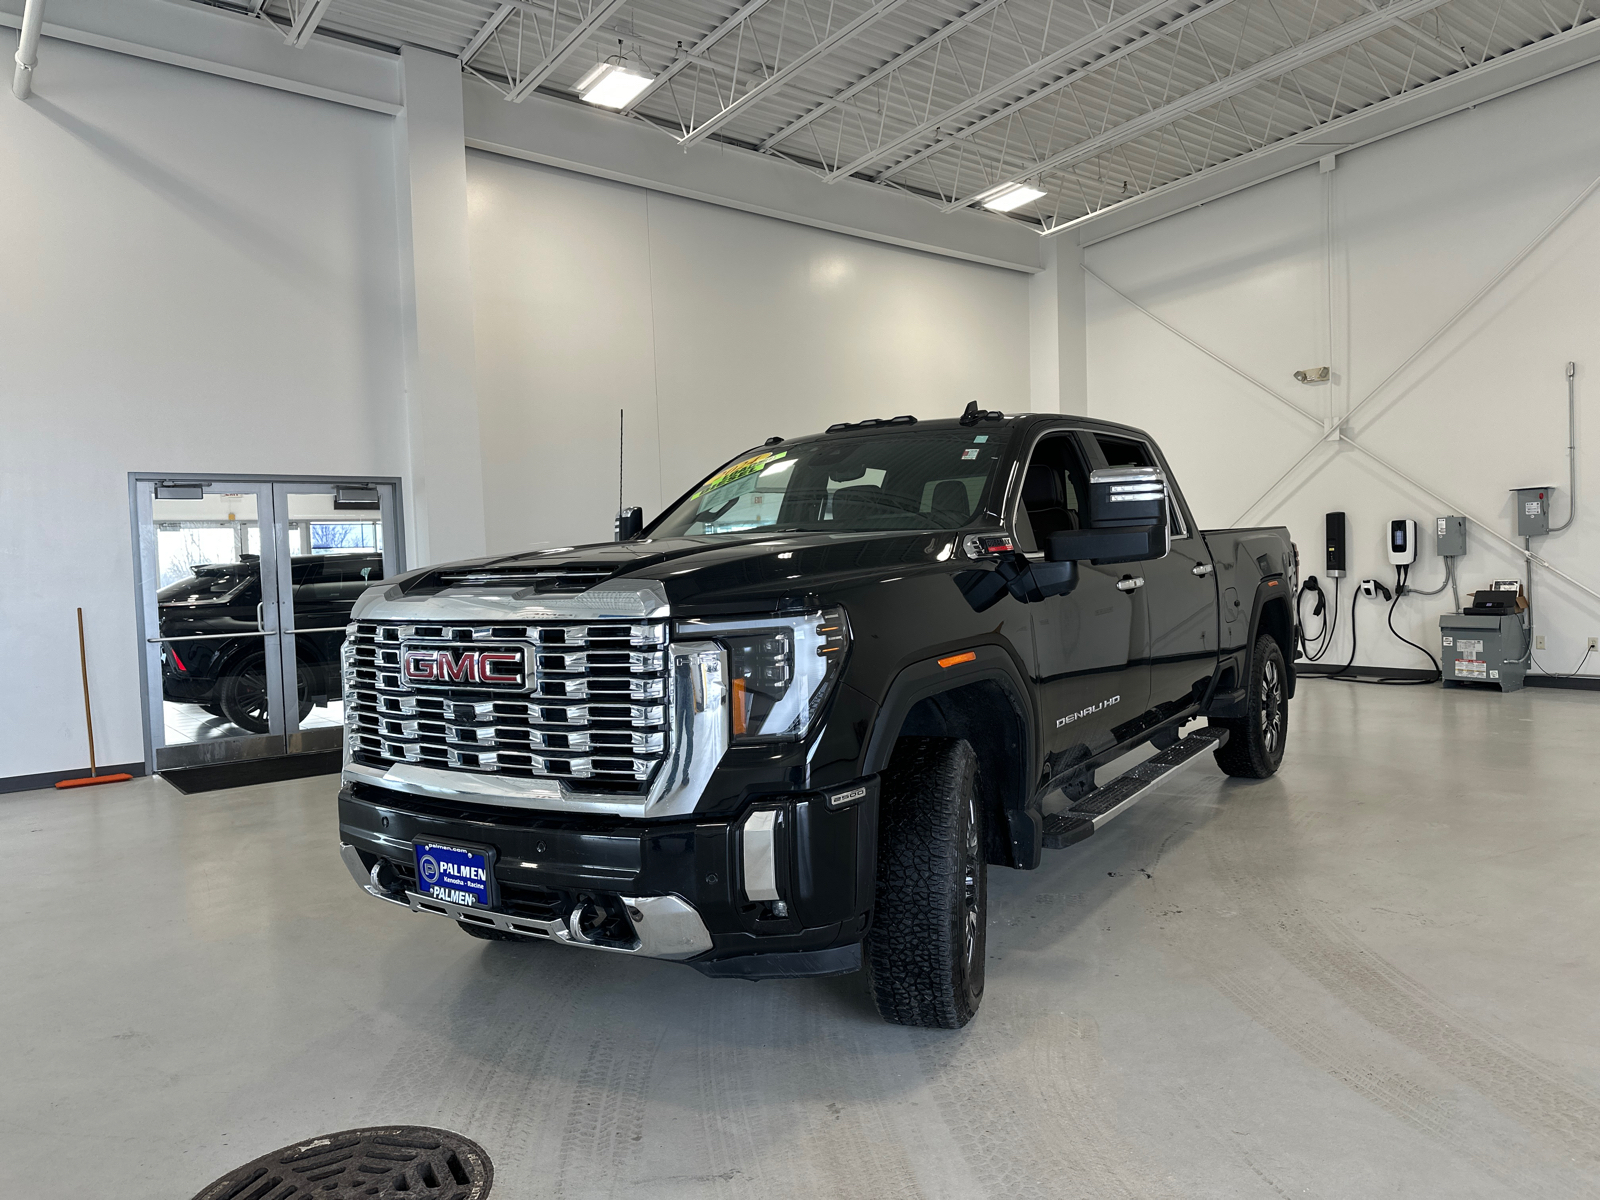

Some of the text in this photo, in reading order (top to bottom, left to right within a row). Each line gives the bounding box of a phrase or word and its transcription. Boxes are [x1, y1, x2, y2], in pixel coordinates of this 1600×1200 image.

[405, 650, 522, 683] GMC
[1056, 694, 1121, 729] DENALI HD
[833, 790, 864, 803] 2500
[428, 843, 468, 854] palmen.com
[439, 861, 487, 882] PALMEN
[443, 876, 464, 886] Kenosha
[467, 880, 485, 890] Racine
[433, 886, 473, 906] PALMEN
